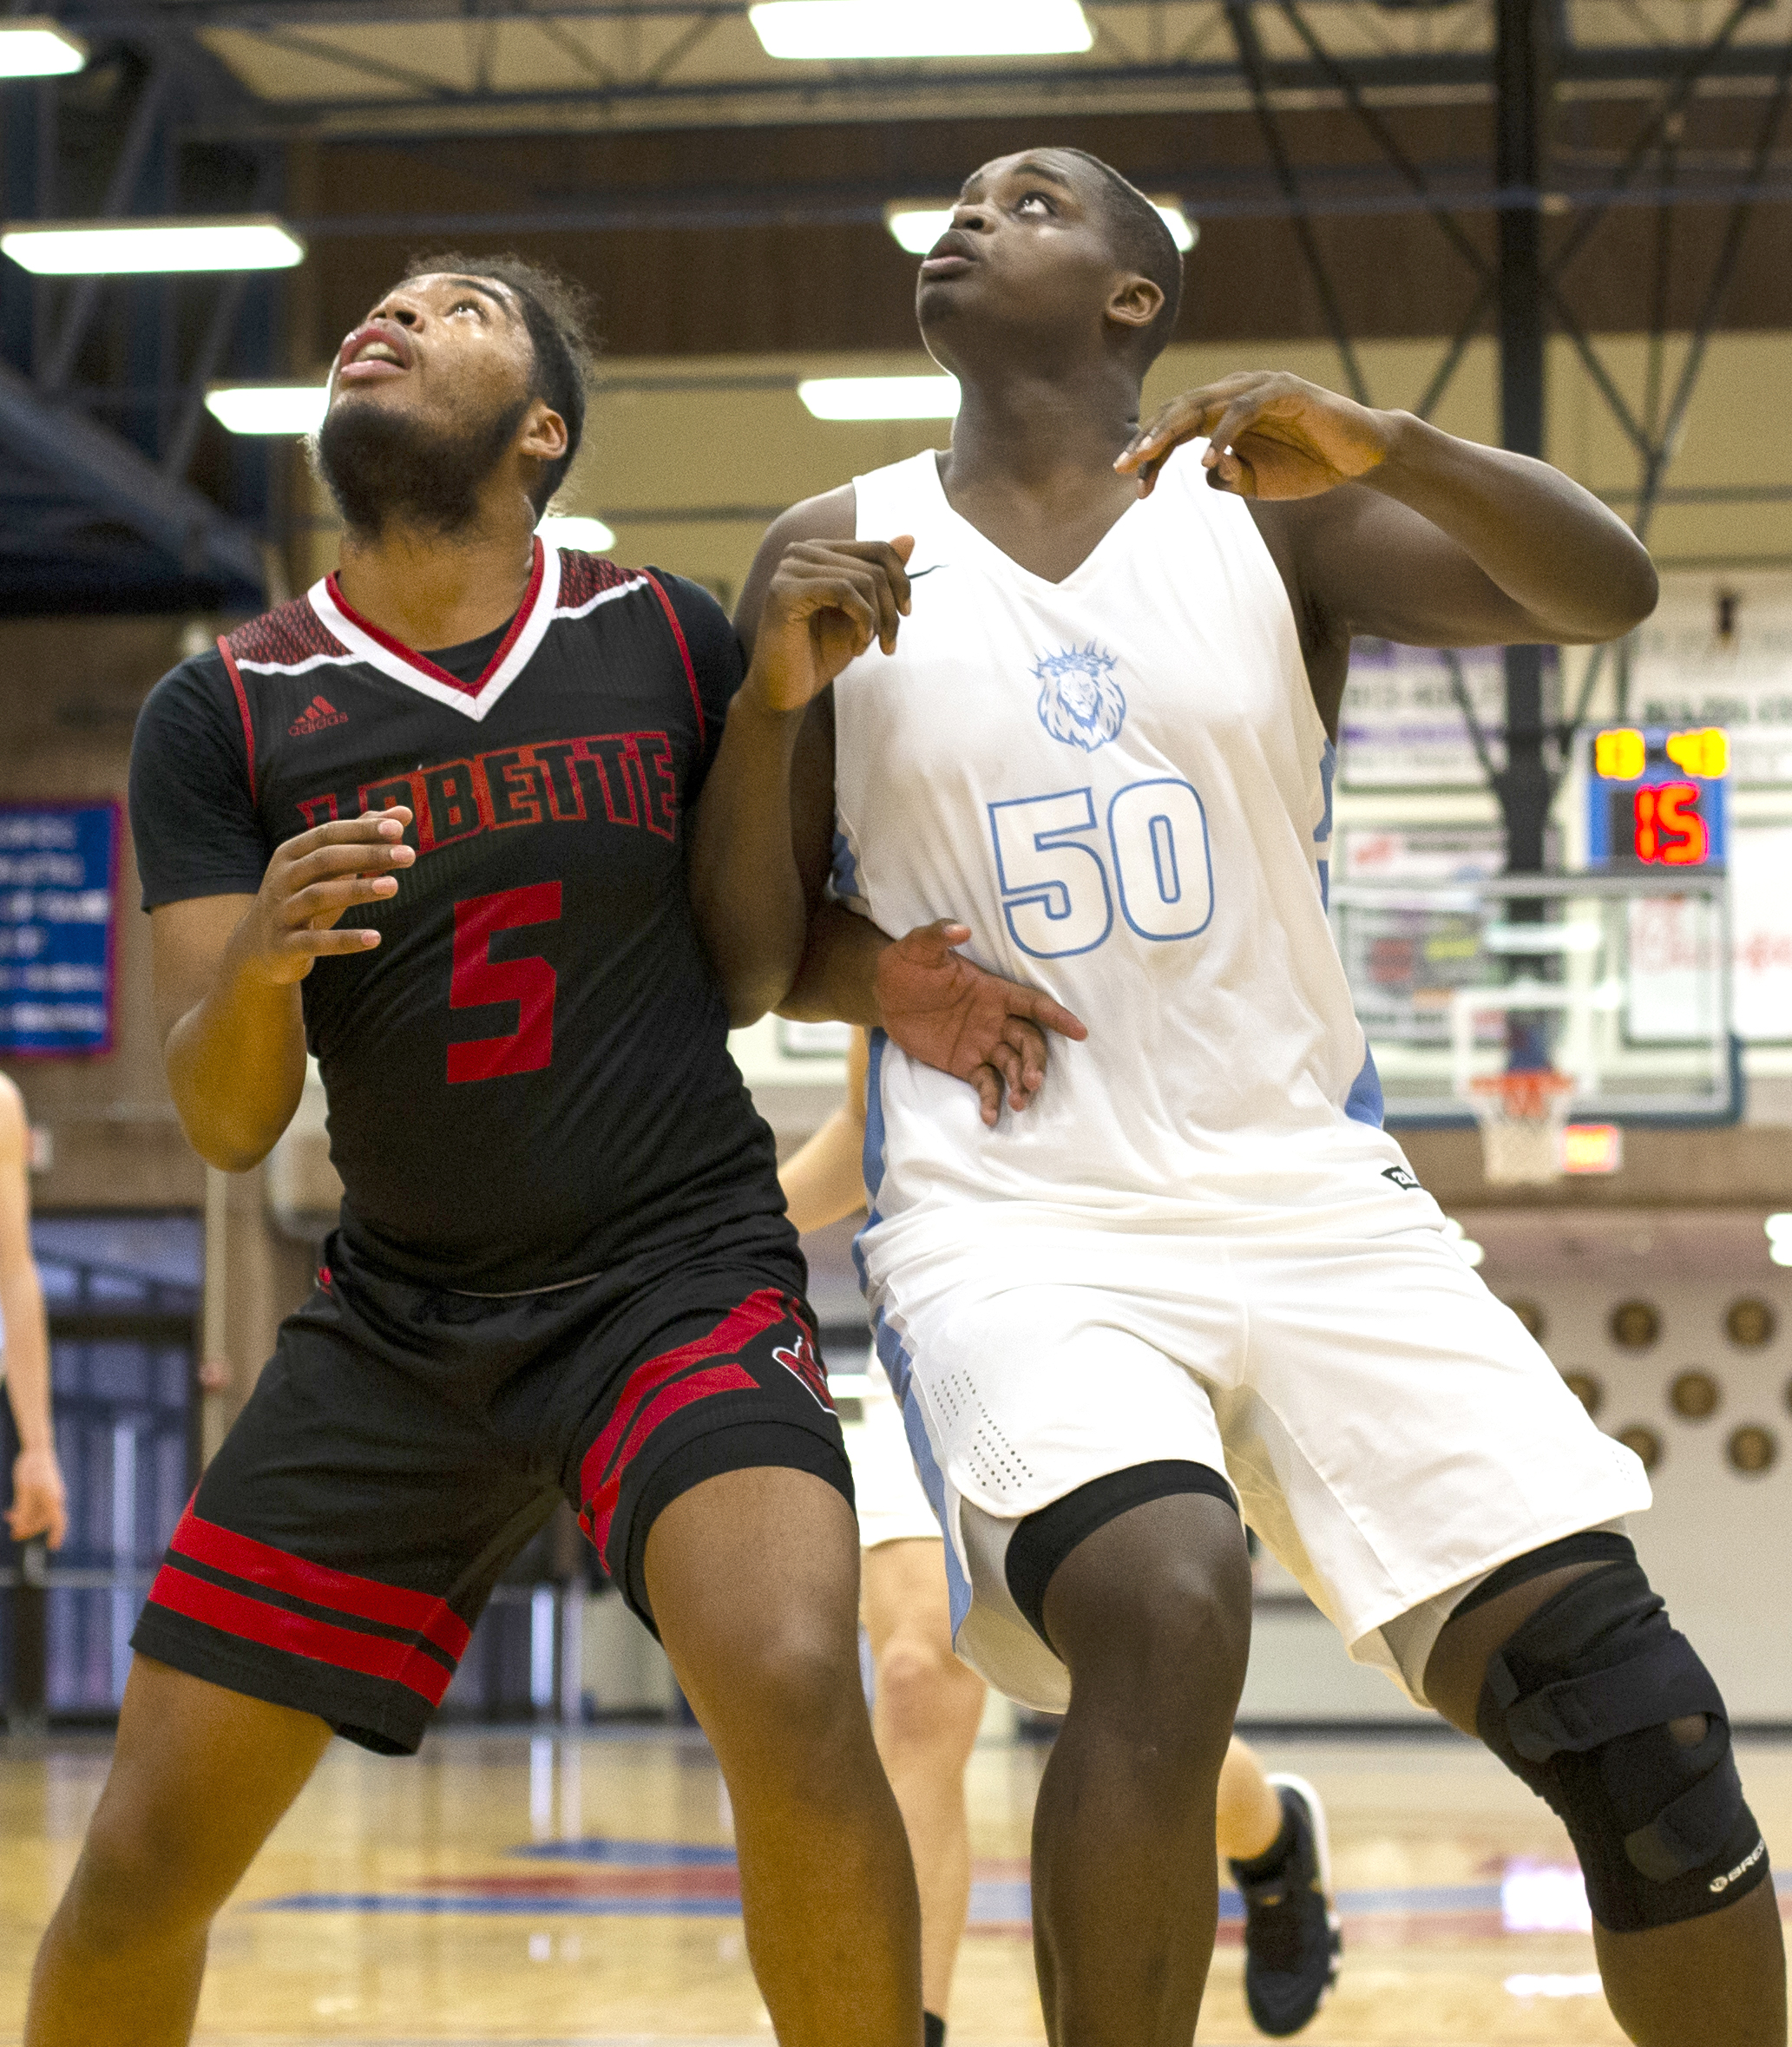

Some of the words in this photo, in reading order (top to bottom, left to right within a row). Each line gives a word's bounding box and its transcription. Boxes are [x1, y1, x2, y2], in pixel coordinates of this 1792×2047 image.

[288, 712, 349, 738] adidas
[987, 777, 1215, 961] 50
[1634, 782, 1710, 866] 15
[446, 881, 562, 1085] 5
